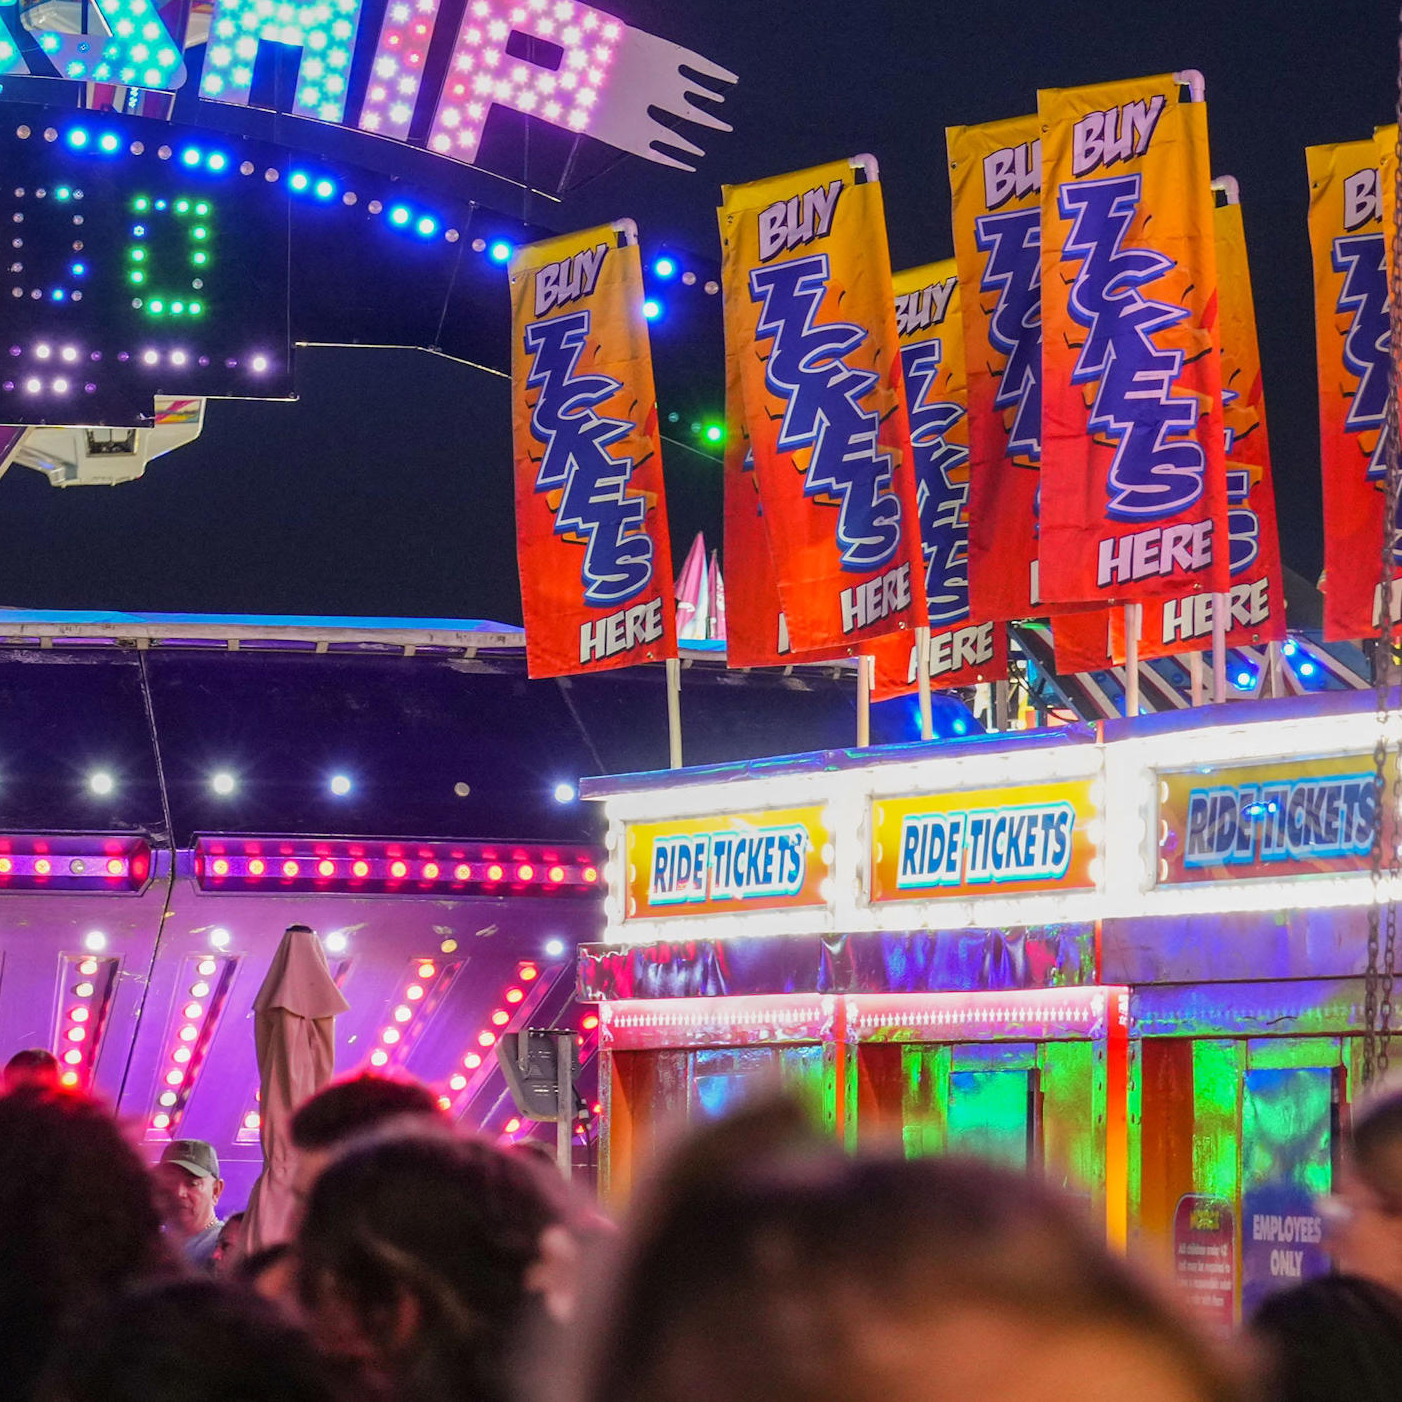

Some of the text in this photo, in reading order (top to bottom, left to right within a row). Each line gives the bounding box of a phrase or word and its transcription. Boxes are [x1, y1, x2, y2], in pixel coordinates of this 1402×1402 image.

[1073, 95, 1165, 177] BUY
[983, 139, 1042, 211] BU
[757, 180, 843, 262] BUY
[534, 243, 608, 318] BUY
[1057, 174, 1207, 523] TICKETS
[748, 253, 902, 573] TICKETS
[524, 309, 654, 608] TICKETS
[1097, 519, 1213, 589] HERE
[579, 597, 664, 664] HERE
[839, 562, 911, 635] HERE
[901, 809, 1070, 878] RIDE TICKETS
[1188, 780, 1377, 857] RIDE TICKETS
[653, 831, 806, 895] RIDE TICKETS
[1252, 1213, 1323, 1245] EMPLOYEES
[1269, 1248, 1305, 1278] ONLY
